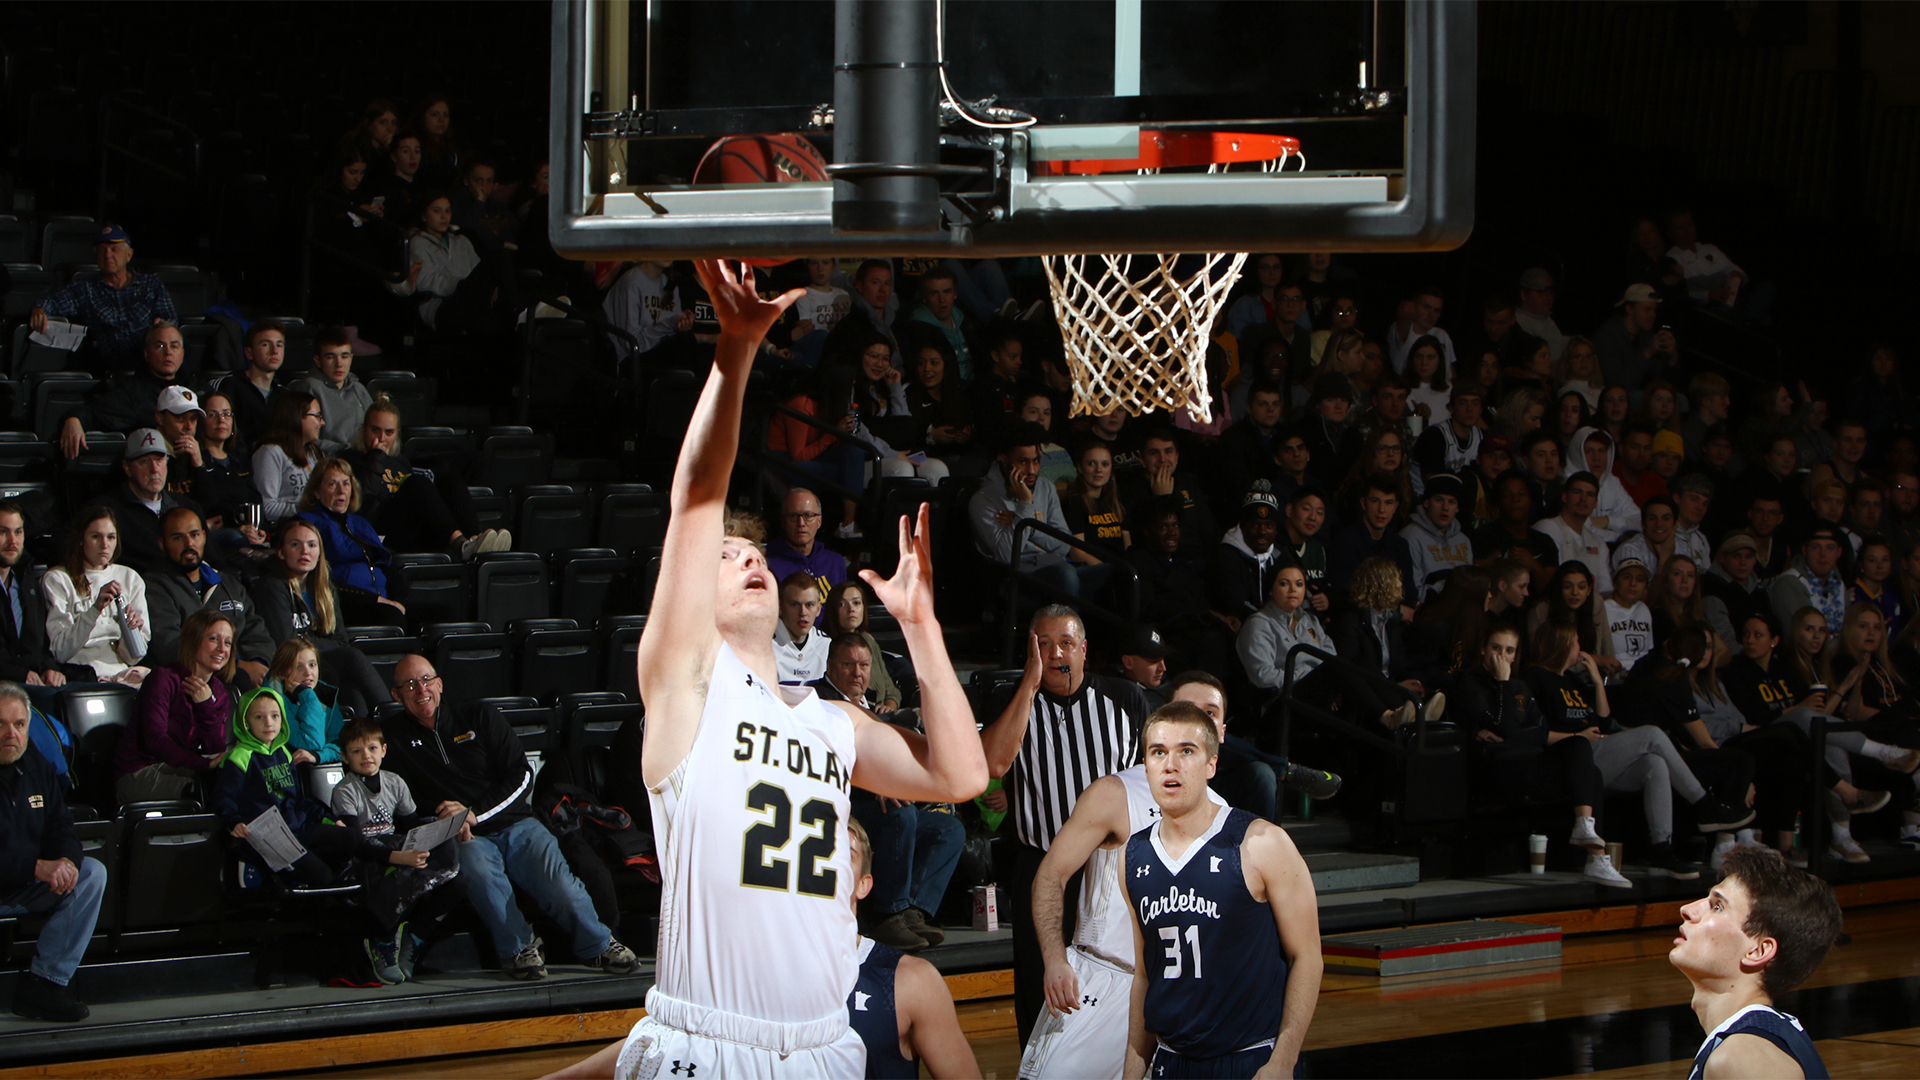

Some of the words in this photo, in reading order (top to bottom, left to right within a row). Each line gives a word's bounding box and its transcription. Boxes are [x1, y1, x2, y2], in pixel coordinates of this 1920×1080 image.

[140, 432, 156, 447] A
[1560, 687, 1589, 708] OLE
[1758, 679, 1794, 703] OLE
[733, 721, 780, 764] ST.
[739, 778, 840, 900] 22
[1140, 885, 1221, 926] Carleton
[1158, 925, 1202, 979] 31
